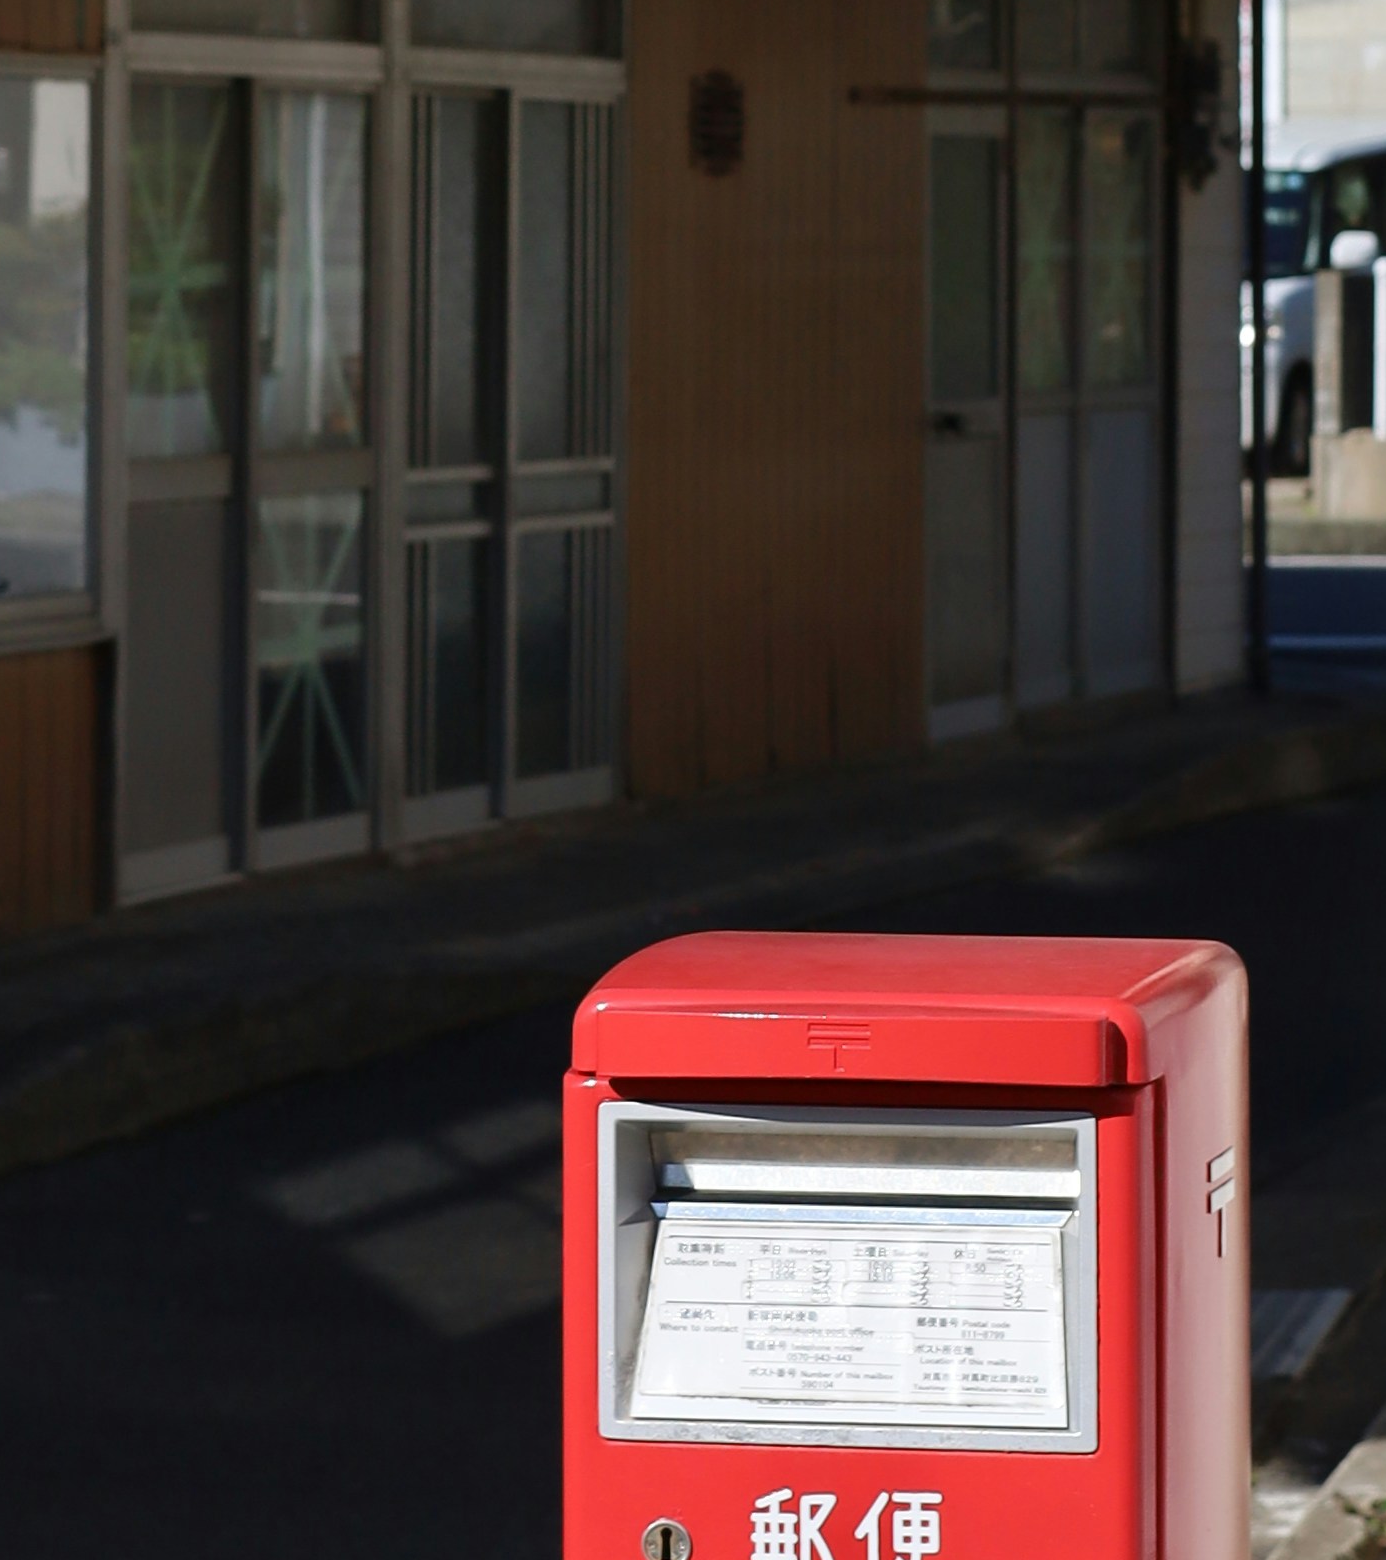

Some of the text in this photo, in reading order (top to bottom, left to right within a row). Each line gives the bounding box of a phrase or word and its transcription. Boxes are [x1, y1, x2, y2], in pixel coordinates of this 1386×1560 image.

[760, 1244, 782, 1256] 平日
[853, 1246, 888, 1258] 土曜日
[664, 1257, 737, 1268] Collection times
[660, 1323, 688, 1332] Where
[703, 1325, 738, 1333] contact
[916, 1317, 1011, 1329] 郵便番号 Postal code
[914, 1345, 974, 1356] ポスト所在地
[919, 1357, 954, 1366] Location
[748, 1366, 796, 1378] ポスト番号
